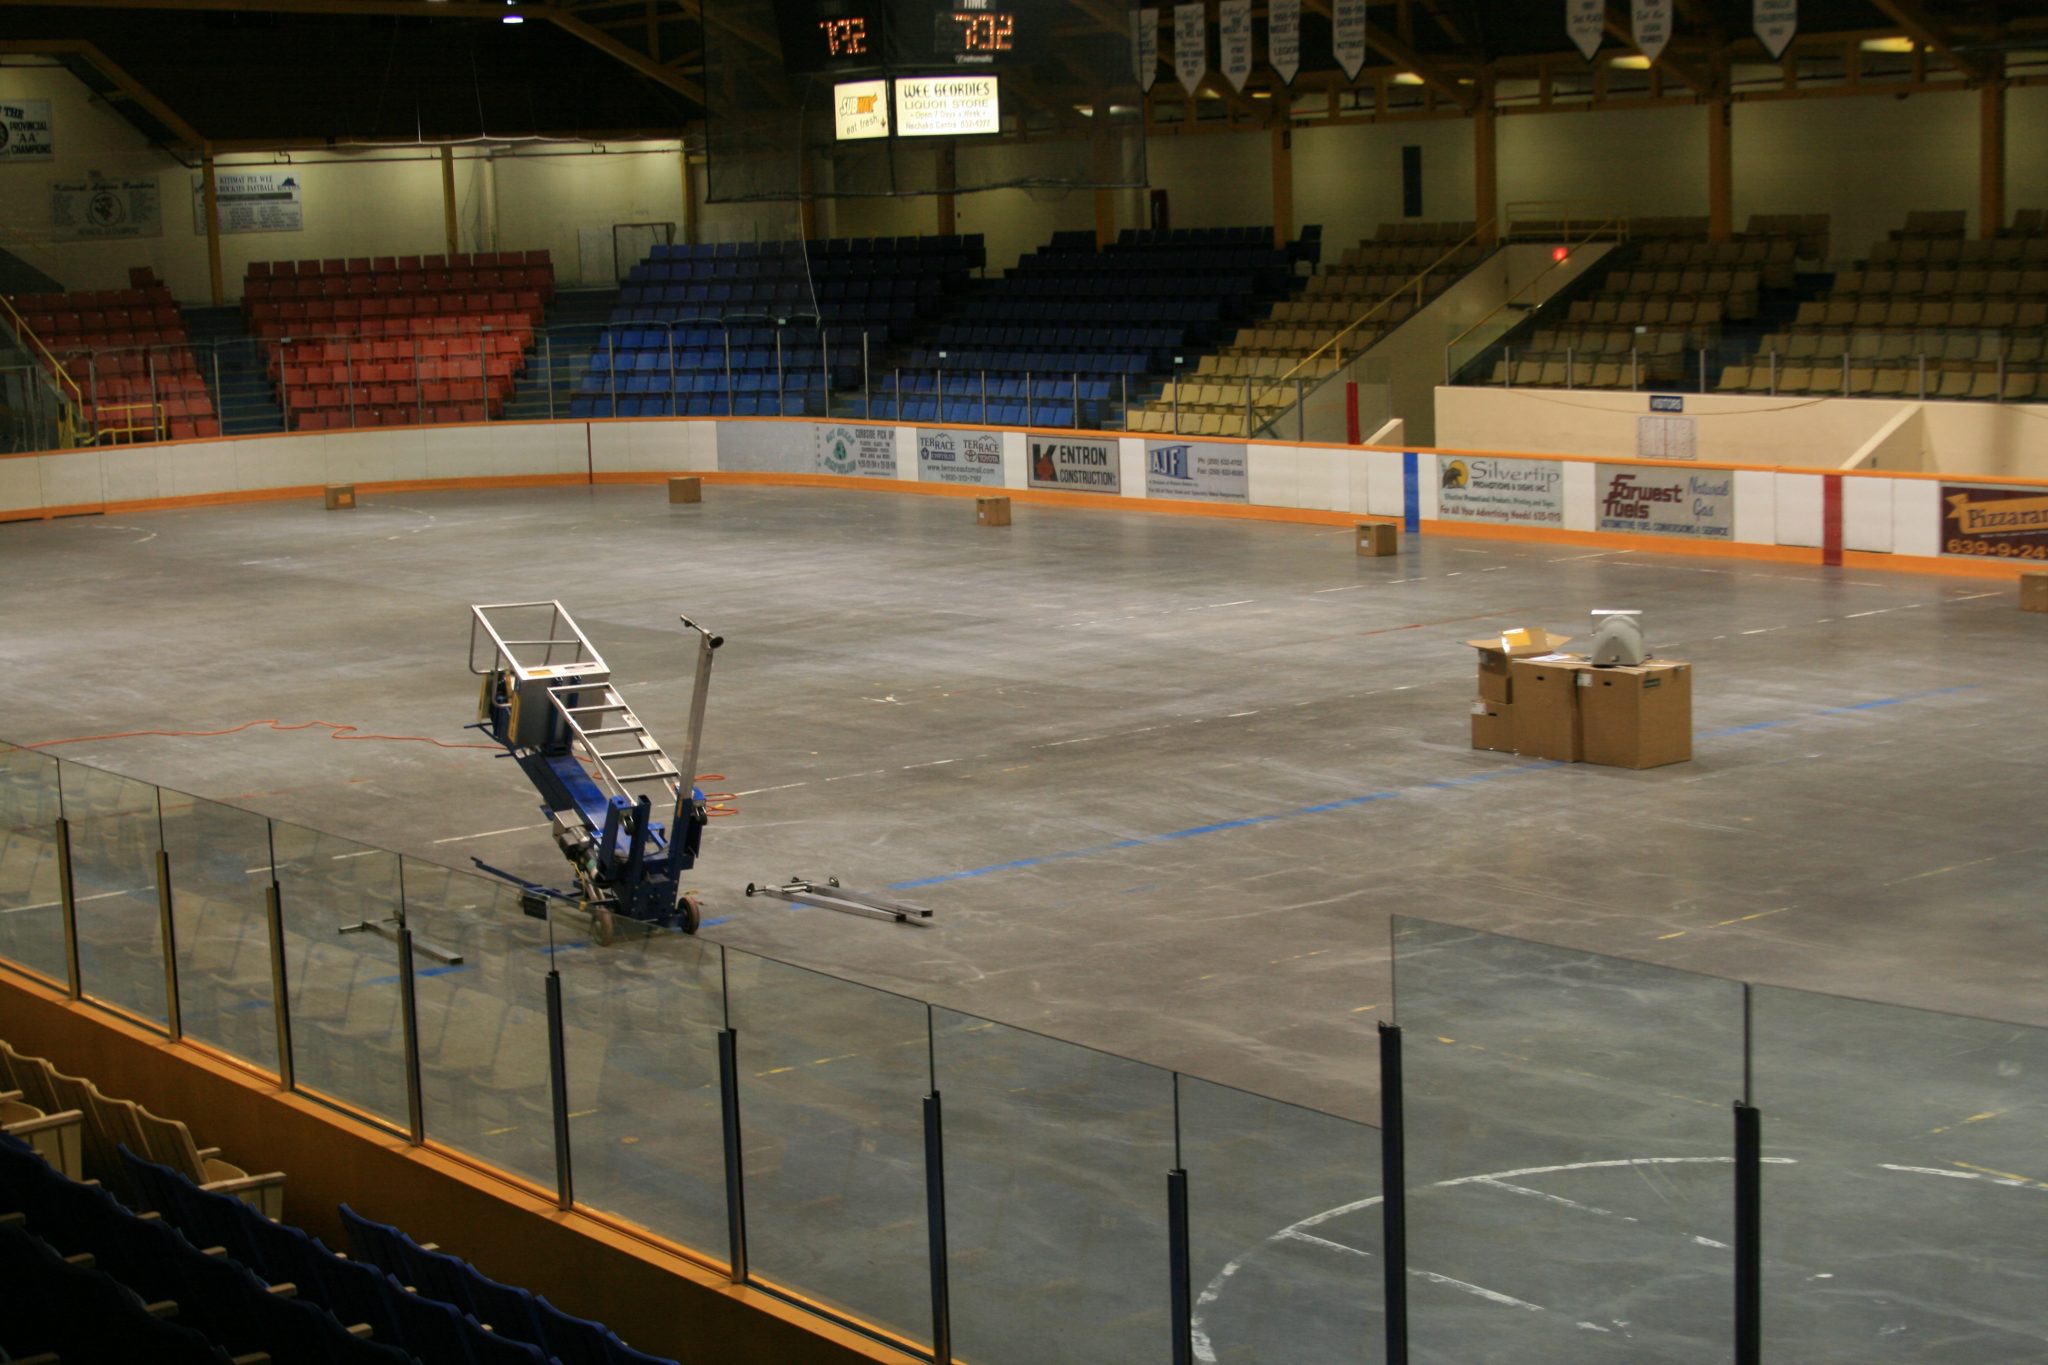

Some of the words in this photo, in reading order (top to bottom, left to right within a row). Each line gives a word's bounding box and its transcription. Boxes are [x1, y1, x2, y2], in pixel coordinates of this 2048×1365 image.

[904, 84, 930, 98] WEE
[935, 82, 989, 98] GEORDIES
[4, 105, 24, 119] THE
[839, 93, 878, 118] SUBWAY
[905, 100, 946, 110] LIQUOR
[952, 99, 988, 109] STORE
[920, 437, 955, 451] TERRACE
[963, 439, 999, 454] TERRACE
[979, 454, 999, 463] TOYOTA
[1152, 448, 1179, 478] AJF
[1059, 468, 1113, 486] CONSTRUCTION
[1471, 460, 1560, 493] Silvertip
[1609, 474, 1683, 503] Farwest
[1688, 476, 1729, 497] Natural
[1692, 497, 1714, 520] Gas
